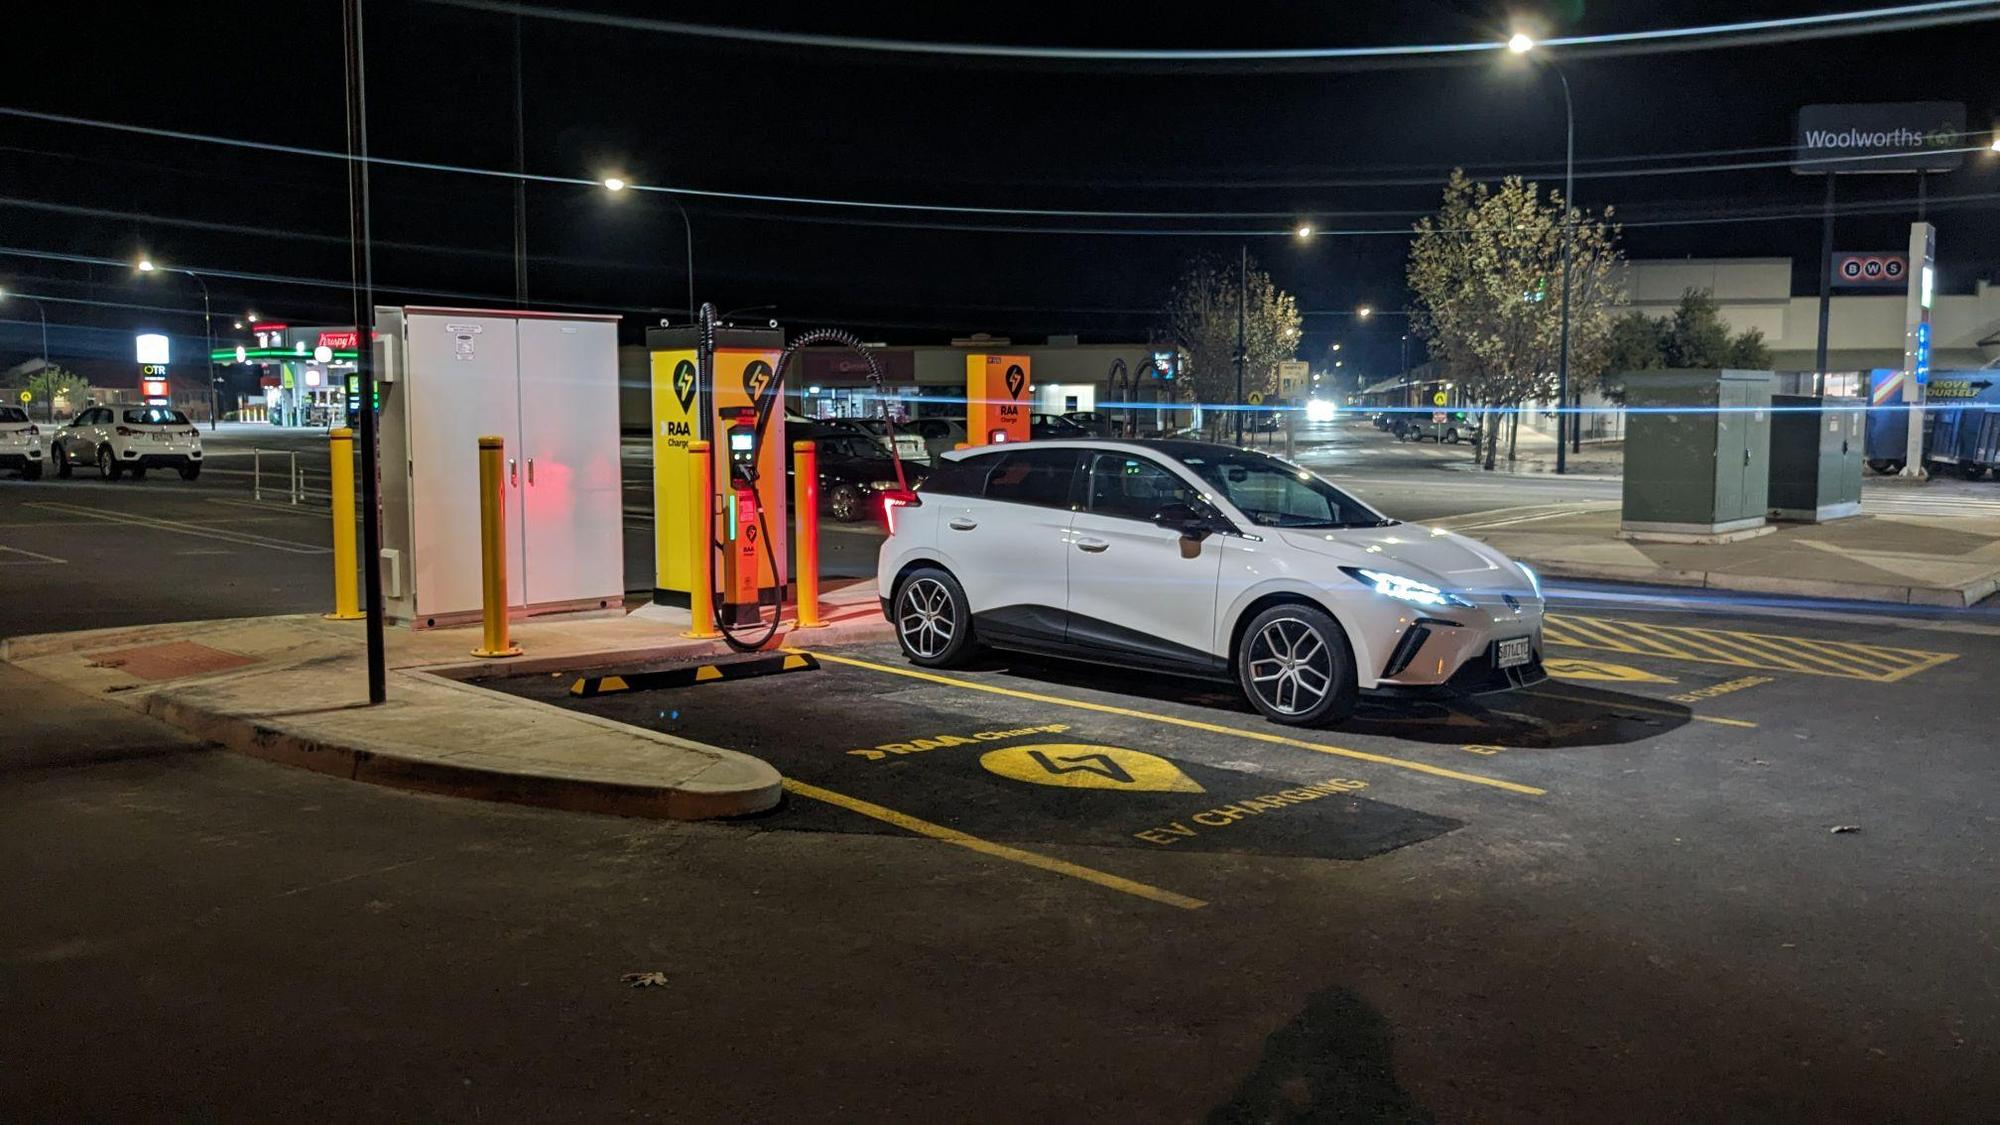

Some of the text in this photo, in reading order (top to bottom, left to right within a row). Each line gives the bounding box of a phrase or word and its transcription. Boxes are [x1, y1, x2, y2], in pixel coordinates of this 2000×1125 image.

[1805, 128, 1923, 148] Woolworths
[144, 365, 166, 375] OTR
[1926, 388, 1981, 397] OURSELF
[1000, 405, 1018, 416] RAA
[667, 421, 691, 436] RAA
[878, 734, 980, 755] RAA
[1133, 777, 1370, 846] EV CHARGING
